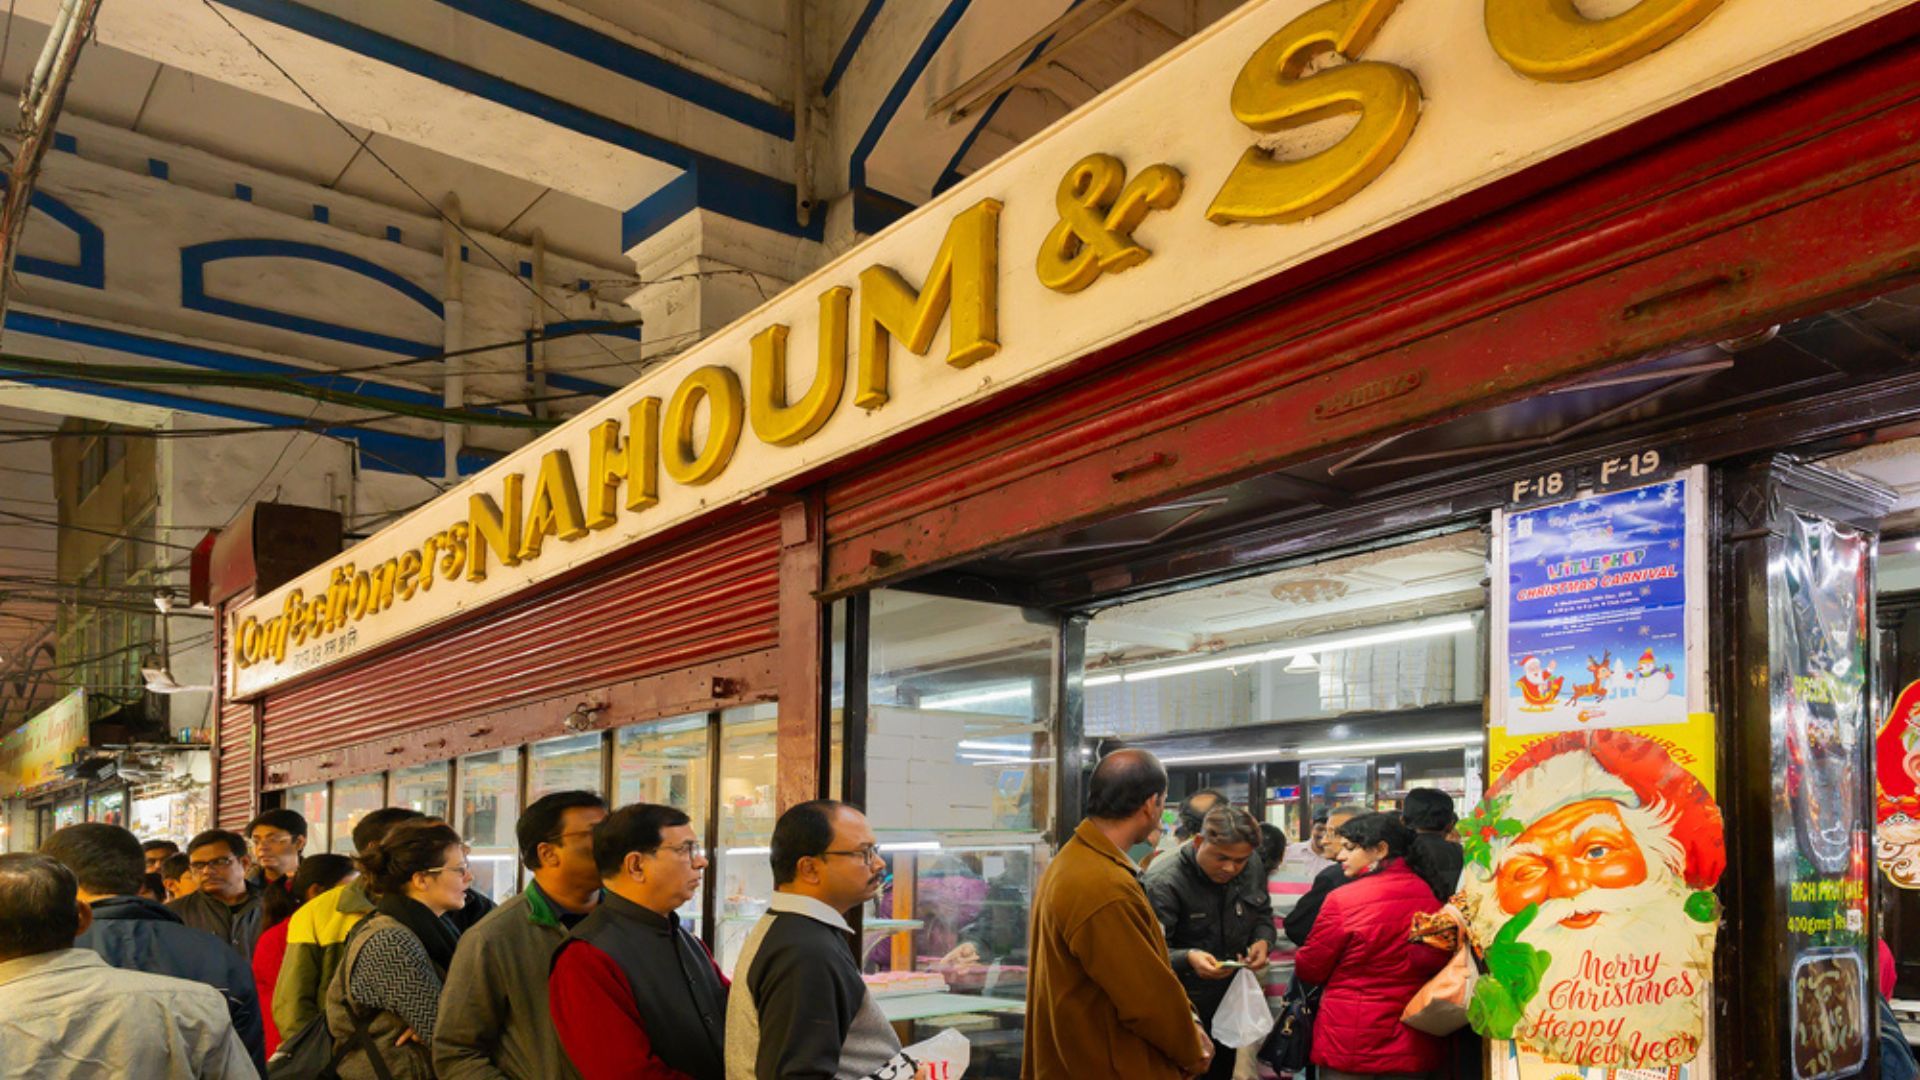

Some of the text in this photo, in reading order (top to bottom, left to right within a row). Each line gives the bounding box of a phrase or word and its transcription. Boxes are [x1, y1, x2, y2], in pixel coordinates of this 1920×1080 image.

[233, 520, 468, 669] Confectioners
[466, 196, 1004, 583] NAHOUM
[1036, 152, 1185, 293] &
[1512, 450, 1660, 502] F-18 F-19
[1517, 577, 1598, 602] CHRISTMAS
[1600, 564, 1678, 588] CARNIVAL
[1491, 750, 1519, 772] OLD
[1791, 881, 1816, 902] RICH
[1573, 949, 1661, 986] Merry
[1548, 970, 1695, 1012] Christmas
[1523, 1009, 1626, 1047] Happy
[1561, 1030, 1697, 1070] New Year
